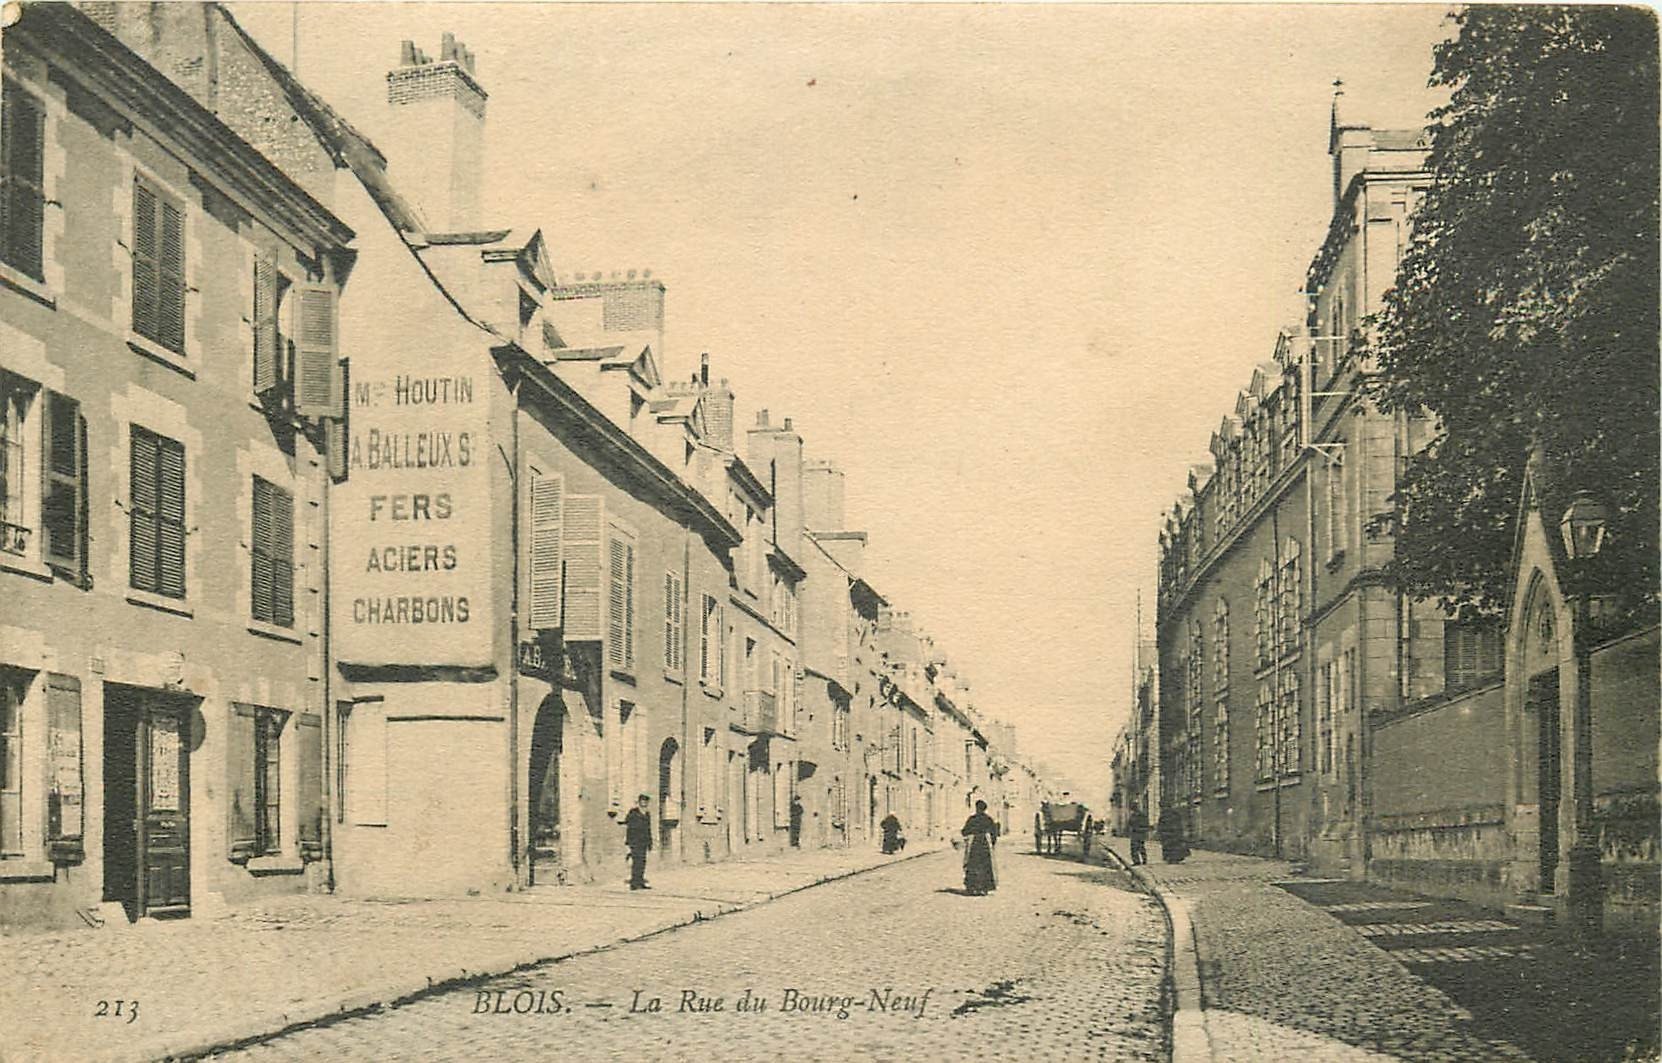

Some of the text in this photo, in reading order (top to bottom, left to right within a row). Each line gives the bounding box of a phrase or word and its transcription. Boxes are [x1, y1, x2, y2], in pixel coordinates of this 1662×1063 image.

[396, 375, 473, 405] HOUTIN
[370, 493, 452, 521] FERS
[367, 545, 457, 572] ACIERS
[353, 597, 470, 624] CHARBONS
